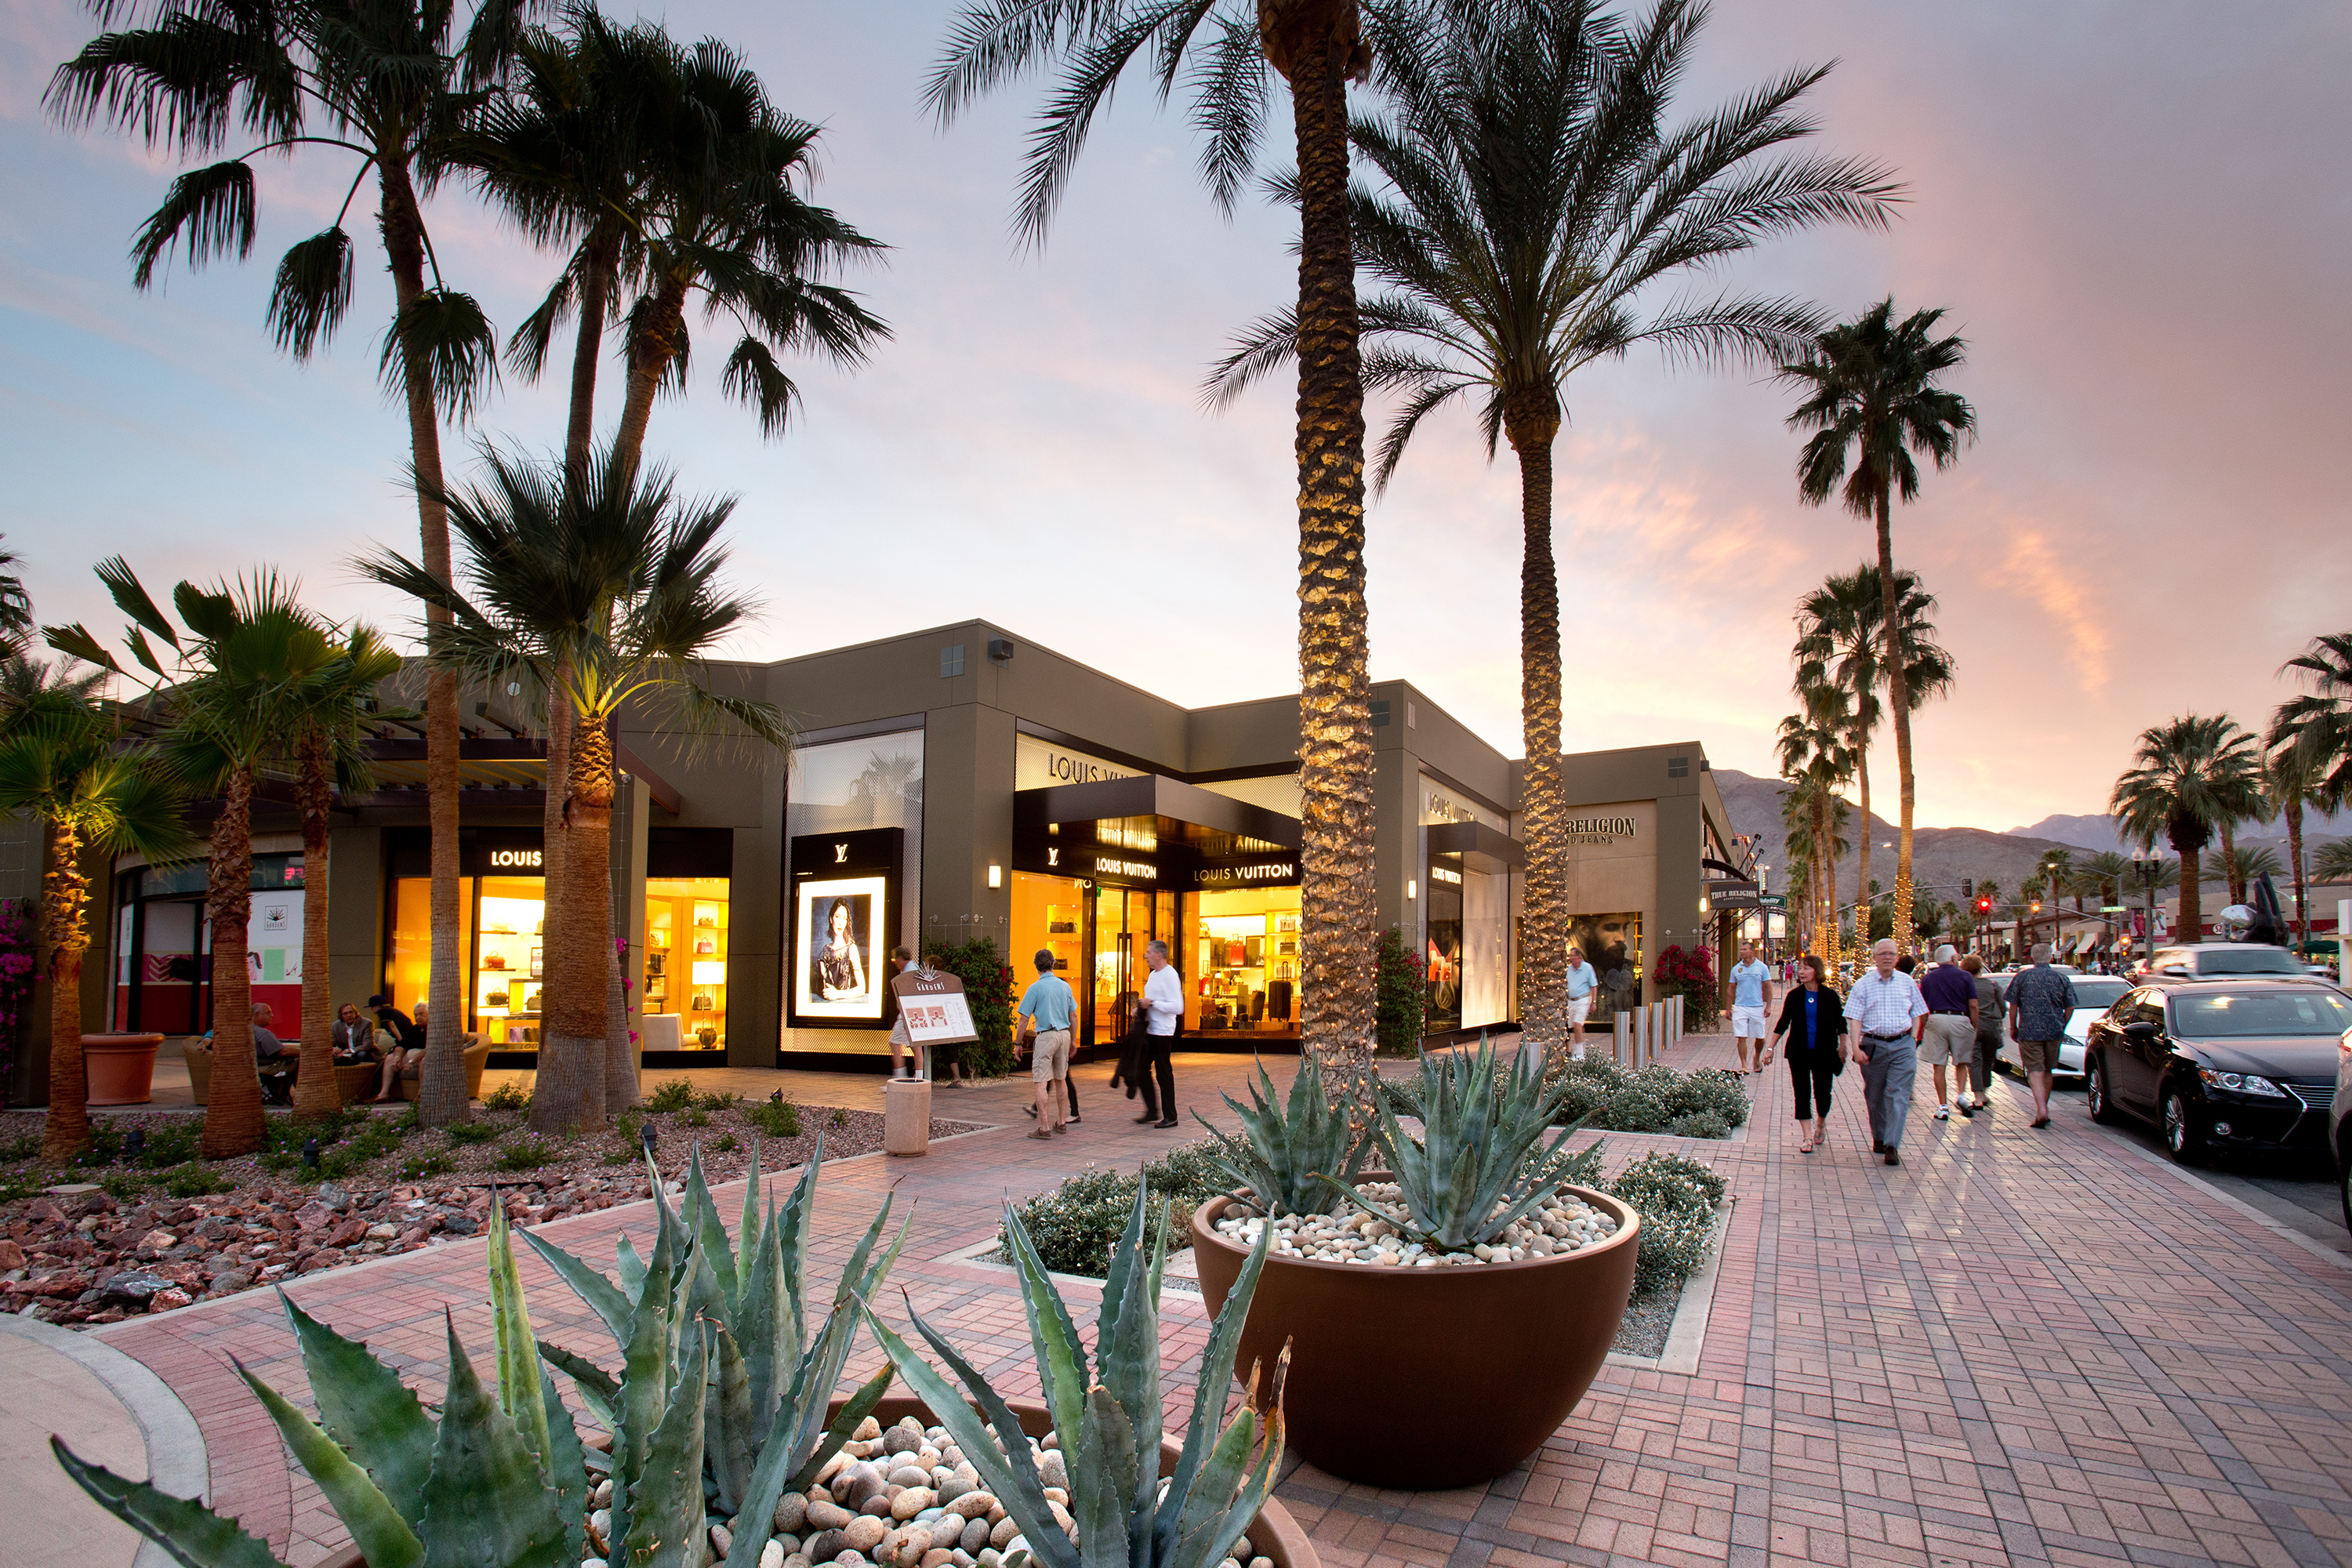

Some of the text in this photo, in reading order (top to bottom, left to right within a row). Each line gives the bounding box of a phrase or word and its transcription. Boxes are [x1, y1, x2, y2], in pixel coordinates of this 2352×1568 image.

[1050, 753, 1098, 783] LOUIS
[1566, 818, 1635, 837] RELIGION
[1581, 835, 1613, 844] JEANS
[491, 851, 543, 866] LOUIS
[1096, 857, 1157, 880] LOUIS VUITTON
[1194, 863, 1293, 881] LOUIS VUITTON
[1432, 866, 1461, 885] LOUIS VUITTON
[1711, 890, 1757, 900] TRUE RELIGION
[916, 982, 945, 992] GARDENS
